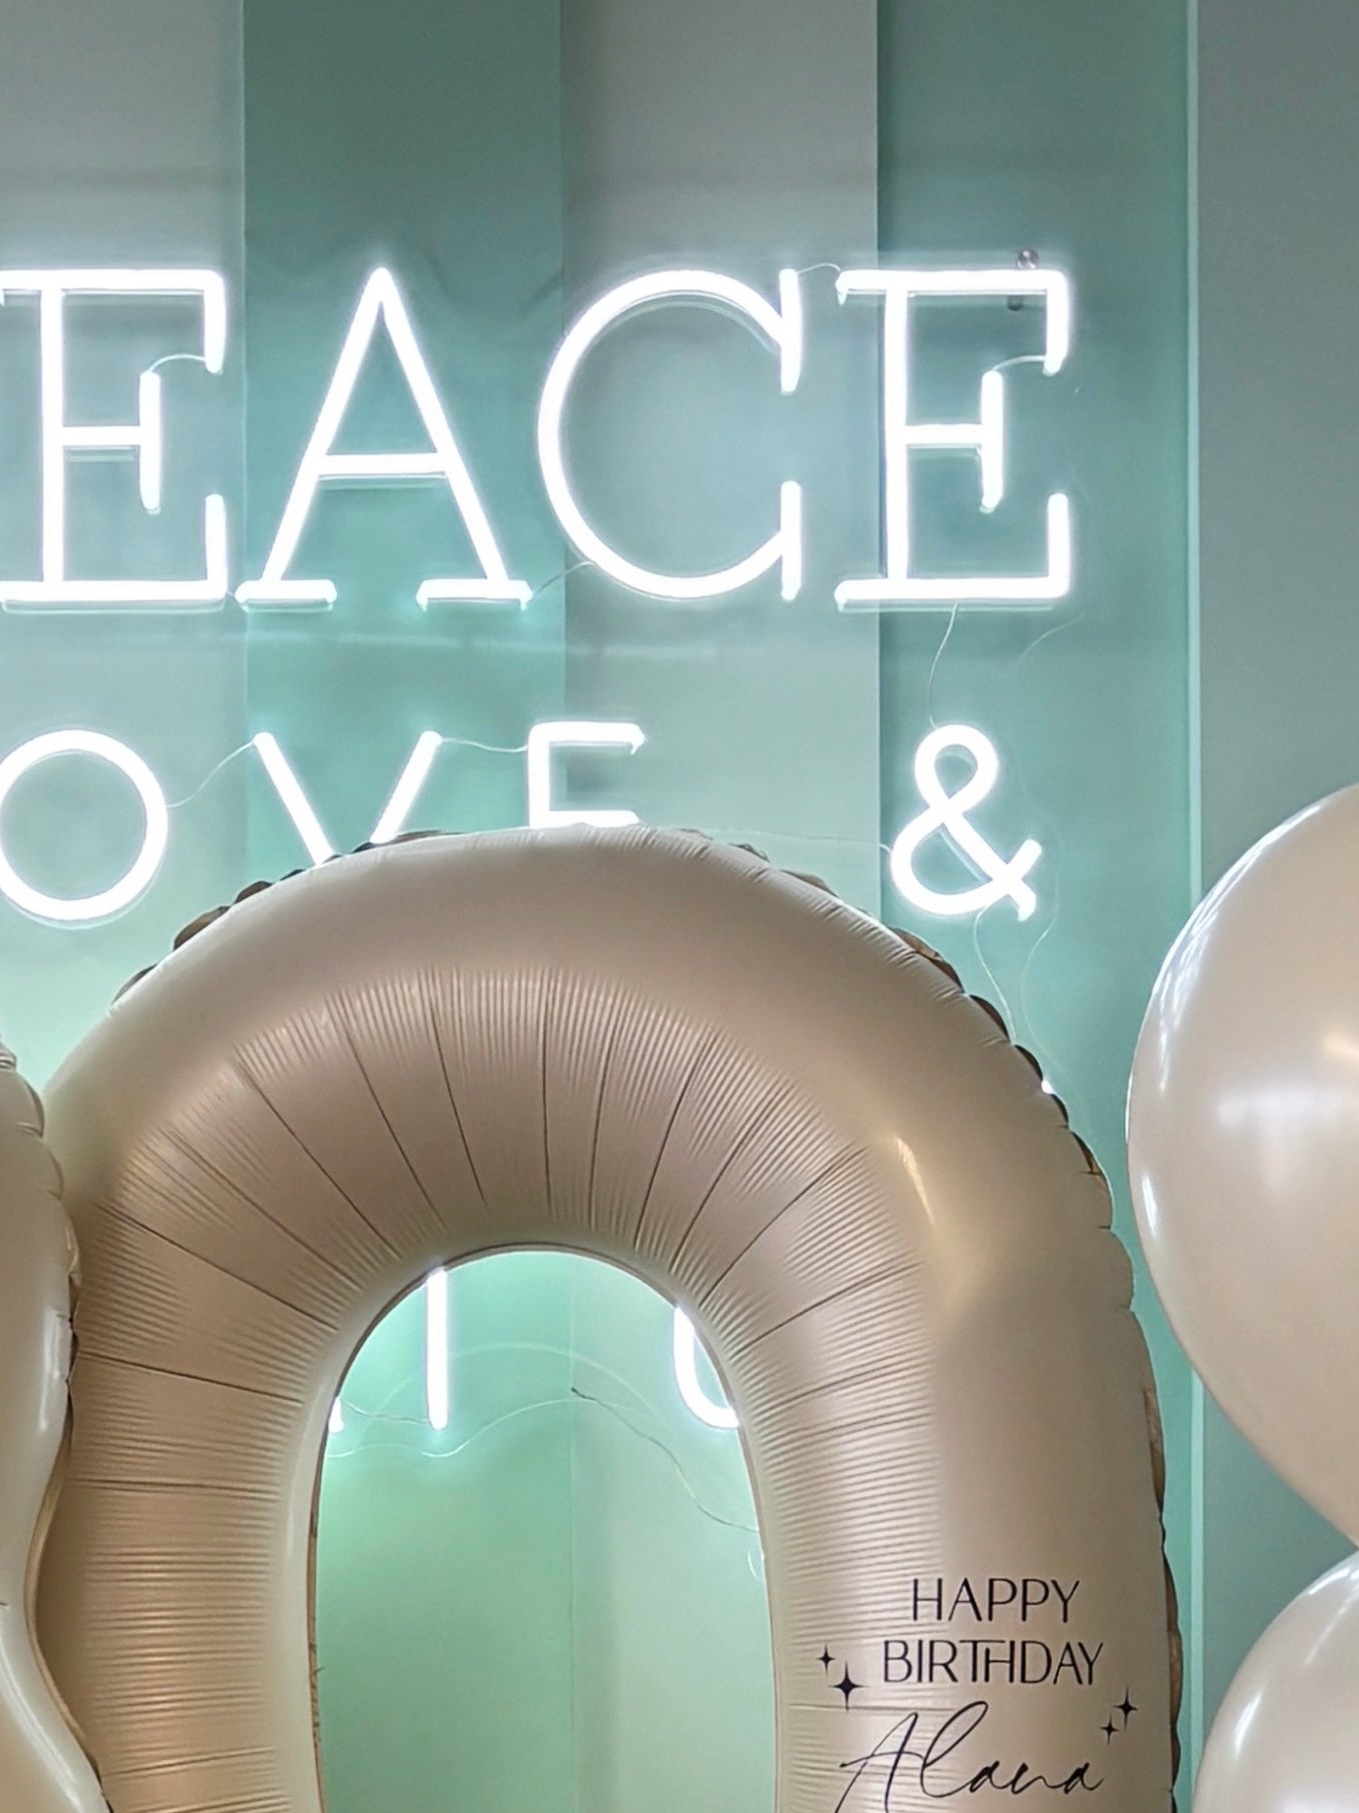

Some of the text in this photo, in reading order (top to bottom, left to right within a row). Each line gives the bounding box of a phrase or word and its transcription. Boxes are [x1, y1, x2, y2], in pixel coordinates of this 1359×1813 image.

[891, 725, 1041, 920] &
[912, 1577, 1080, 1623] HAPPY
[884, 1639, 1104, 1685] BIRTHDAY
